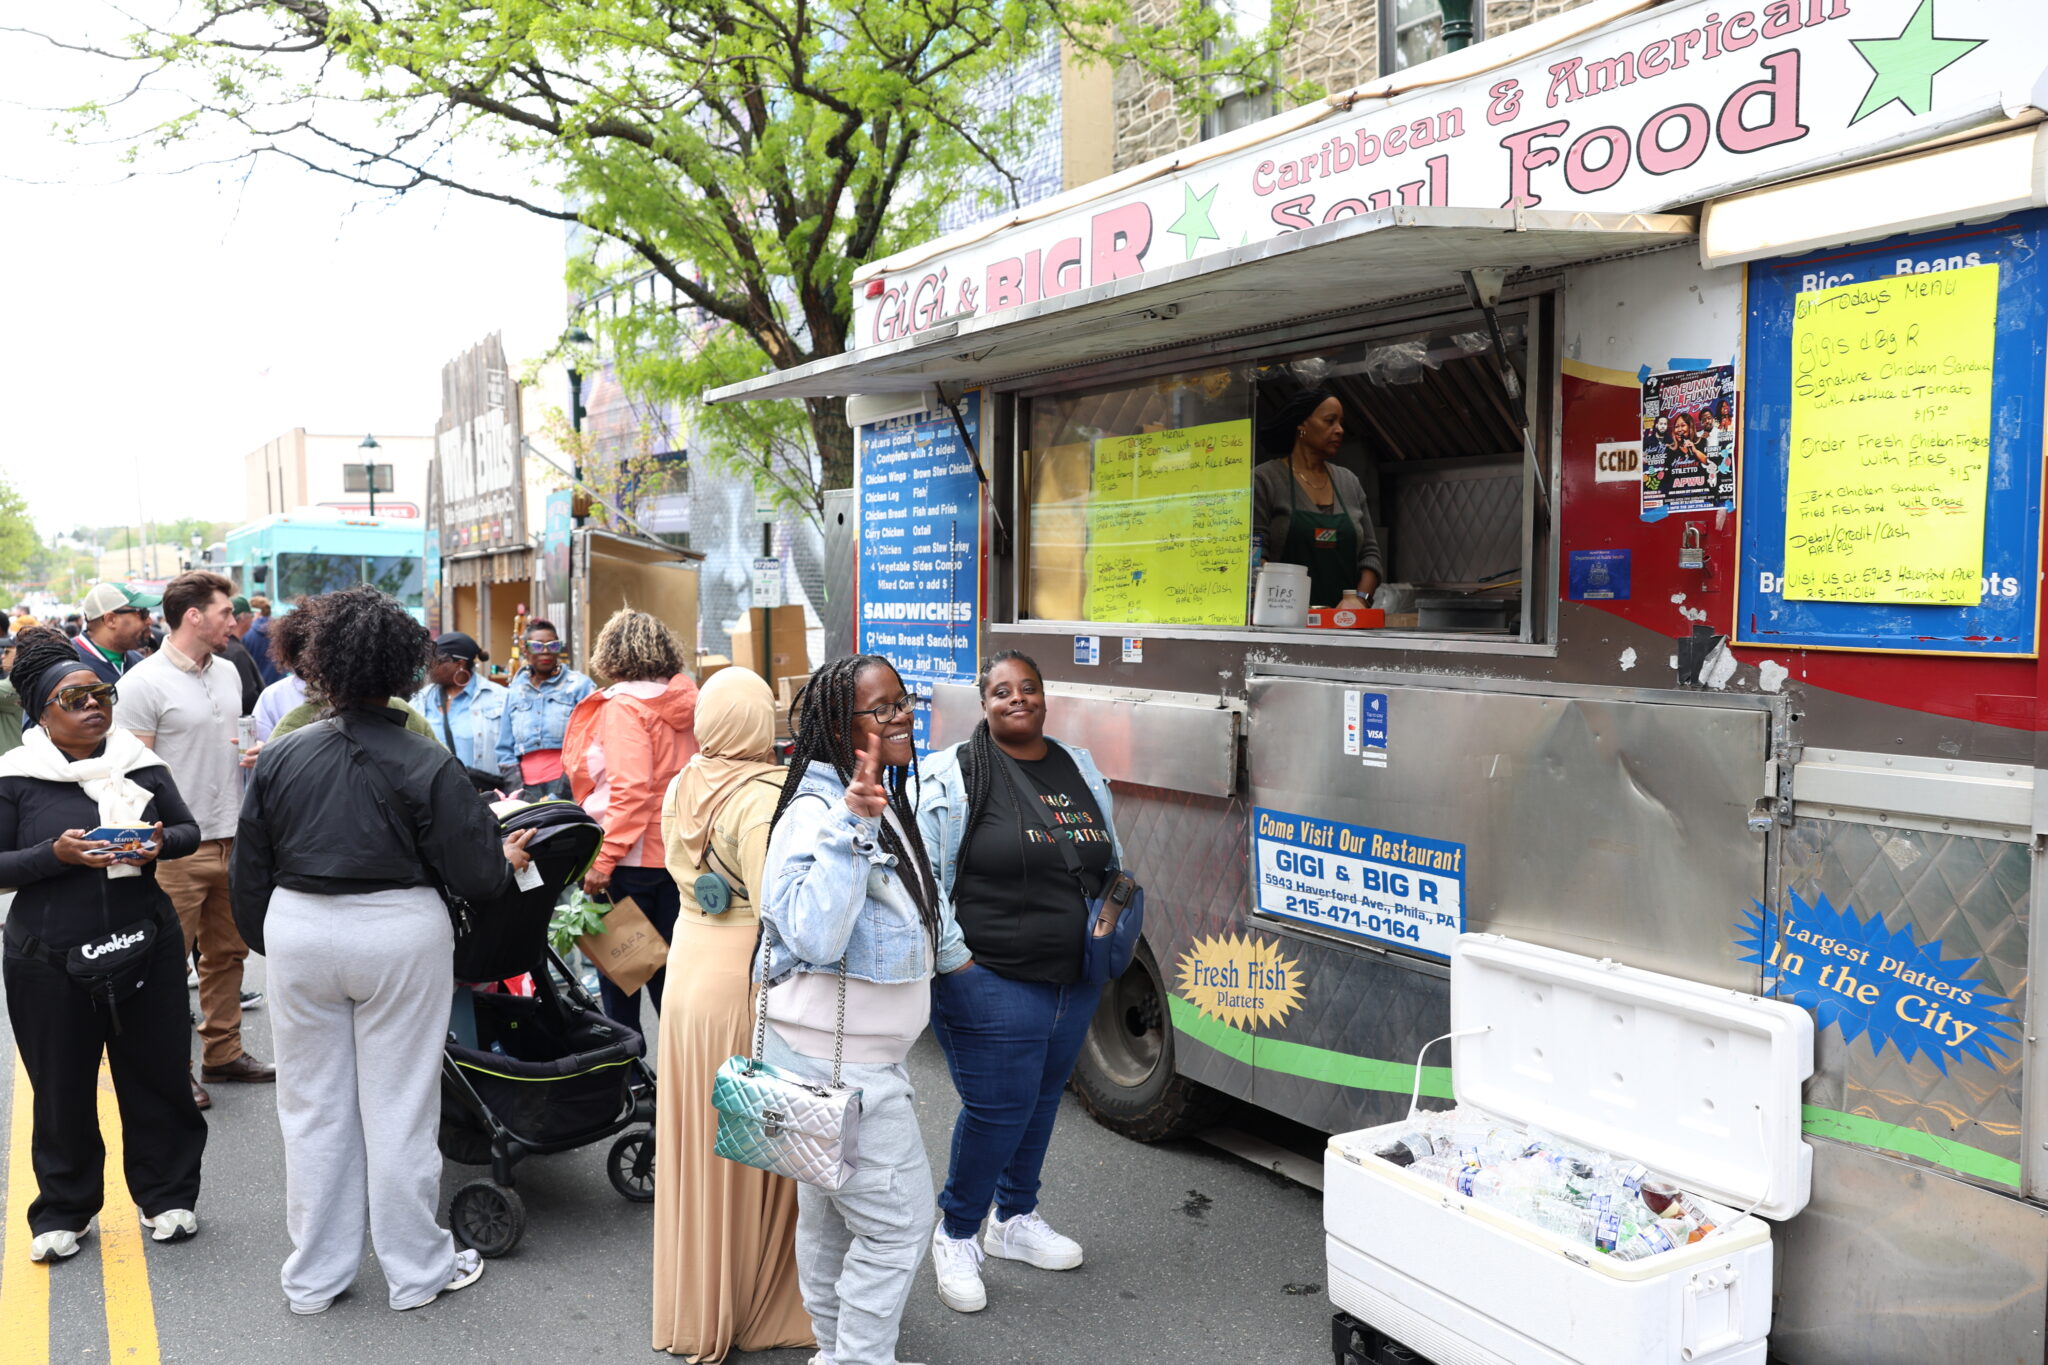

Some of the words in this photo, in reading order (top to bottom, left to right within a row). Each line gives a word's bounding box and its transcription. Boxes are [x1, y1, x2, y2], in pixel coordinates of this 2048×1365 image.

[1252, 103, 1464, 197] Caribbean
[1486, 79, 1522, 126] &
[1545, 0, 1851, 109] American
[1500, 47, 1810, 208] Food
[956, 277, 979, 314] &
[986, 237, 1082, 313] BIG
[1091, 201, 1153, 286] R
[1907, 323, 1919, 347] R
[1880, 361, 1937, 379] Chicken
[1680, 375, 1718, 394] BUNNY
[1912, 382, 1972, 399] Tomato
[1683, 386, 1721, 406] FUNNY
[928, 446, 933, 457] 2
[935, 444, 956, 455] sides
[1801, 432, 1846, 459] Order
[1858, 433, 1903, 449] Fresh
[1600, 449, 1638, 472] CCHD
[1862, 450, 1899, 466] with
[1909, 451, 1947, 467] Fries
[948, 463, 973, 475] Chicken
[1673, 476, 1705, 488] APWU
[1718, 484, 1733, 493] $35
[1837, 484, 1884, 497] Chicken
[865, 491, 887, 503] Chicken
[913, 487, 926, 498] Fish
[865, 509, 887, 521] Chicken
[913, 506, 926, 517] Fish
[928, 505, 939, 516] and
[941, 504, 957, 515] Fries
[1832, 504, 1861, 515] Fish
[1931, 496, 1964, 507] Bread
[882, 527, 904, 538] Chicken
[913, 560, 933, 571] Sides
[926, 580, 940, 590] add
[864, 602, 971, 621] SANDWICHES
[898, 633, 924, 647] Breast
[926, 634, 968, 649] Sandwich
[899, 655, 913, 670] Leg
[915, 656, 931, 670] and
[1366, 729, 1383, 739] VISA
[1259, 814, 1294, 840] Come
[1301, 821, 1334, 848] Visit
[1339, 829, 1366, 854] Our
[1371, 834, 1461, 873] Restaurant
[1276, 849, 1324, 879] GIGI
[1336, 865, 1350, 882] &
[1363, 867, 1410, 898] BIG
[1419, 878, 1438, 905] R
[1265, 873, 1293, 890] 5943
[1296, 880, 1357, 904] Haverford
[1361, 895, 1391, 915] Ave.,
[1394, 903, 1433, 925] Phila.,
[1436, 913, 1456, 928] PA
[1286, 895, 1420, 942] 215-471-0164
[81, 930, 145, 959] Cookies
[611, 931, 646, 959] SAFA
[1784, 919, 1871, 966] Largest
[1877, 955, 1974, 1005] Platters
[1193, 959, 1239, 988] Fresh
[1247, 961, 1286, 990] Fish
[1217, 991, 1265, 1010] Platters
[1766, 941, 1804, 976] In
[1818, 964, 1880, 1006] the
[1895, 994, 1978, 1047] City
